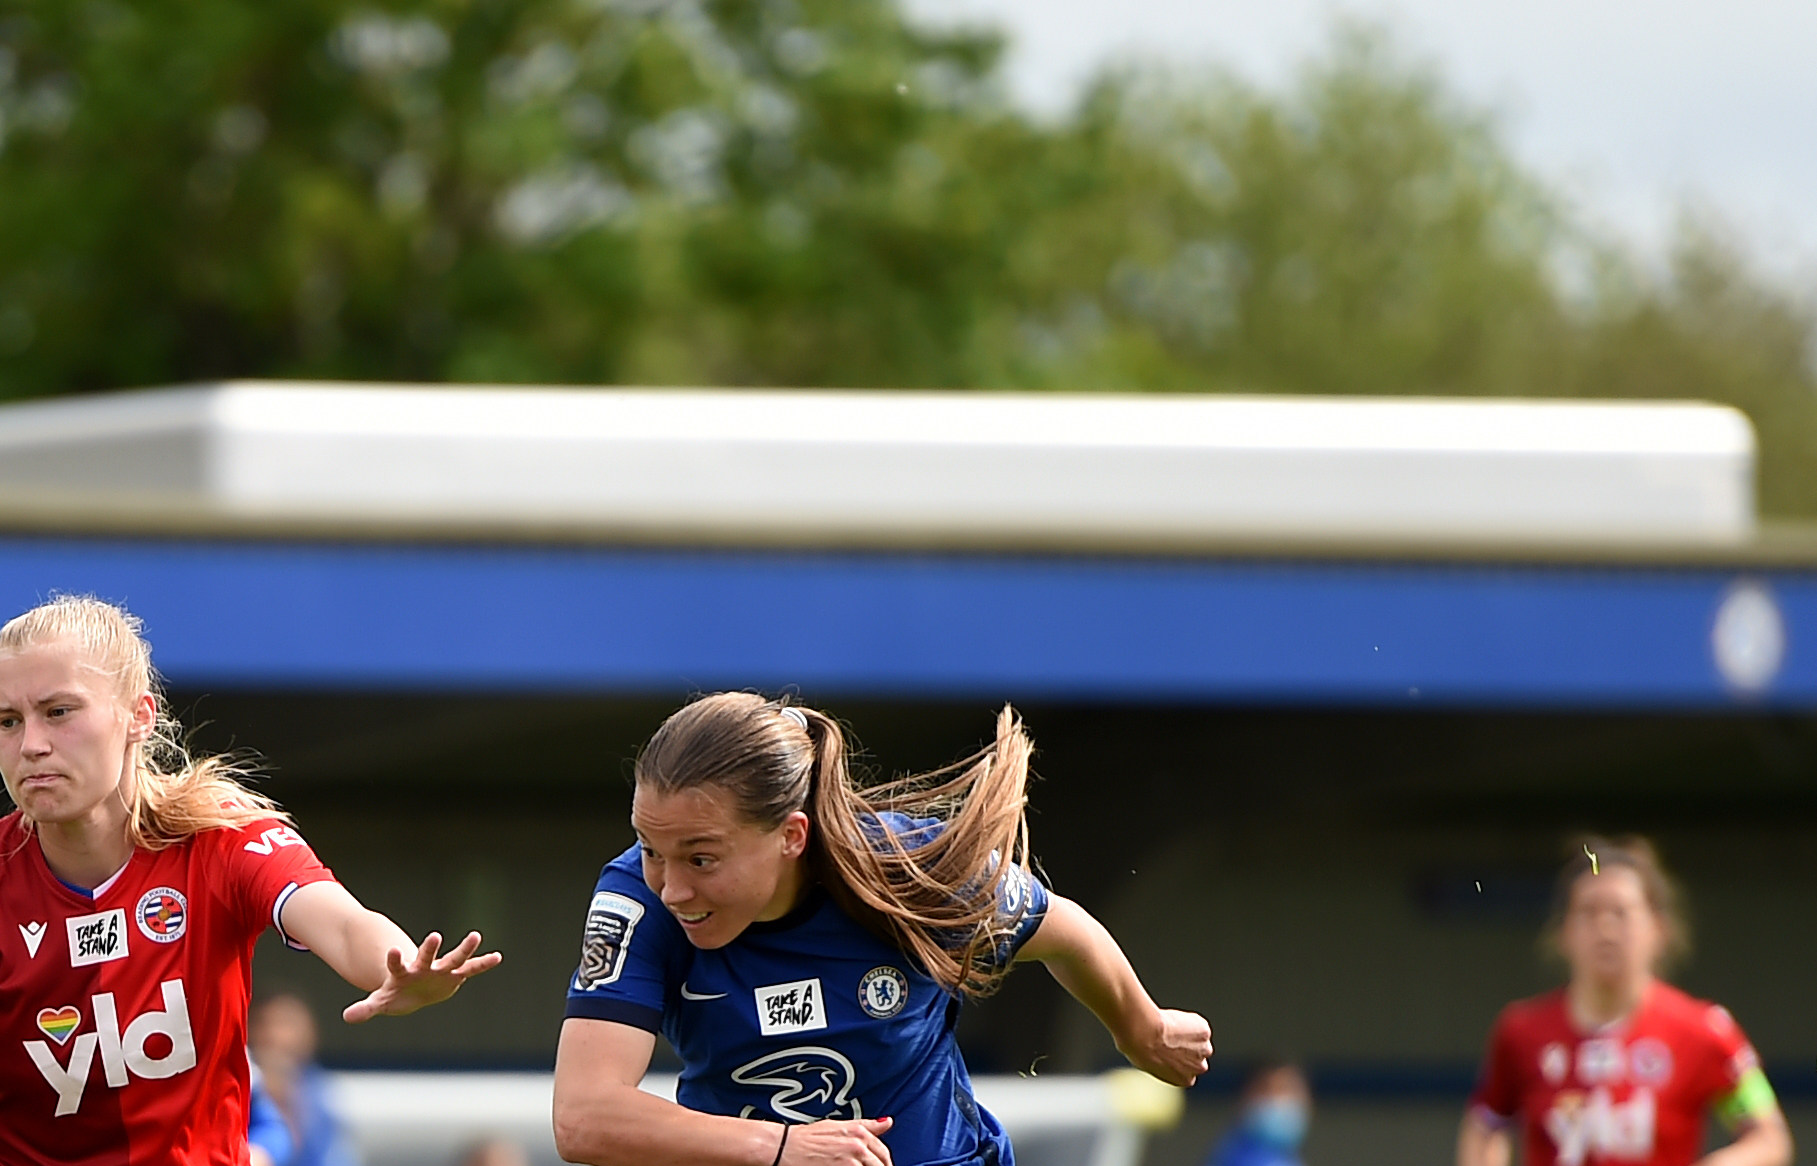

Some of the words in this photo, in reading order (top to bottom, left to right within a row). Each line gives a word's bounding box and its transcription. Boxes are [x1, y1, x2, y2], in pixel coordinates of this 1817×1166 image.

[76, 918, 106, 941] TAKE
[109, 914, 118, 931] A
[78, 932, 119, 957] STAND.
[864, 967, 897, 983] CHELSEA
[764, 988, 799, 1011] TAKE
[803, 984, 813, 1001] A
[768, 1003, 814, 1026] STAND.
[22, 978, 197, 1117] yld
